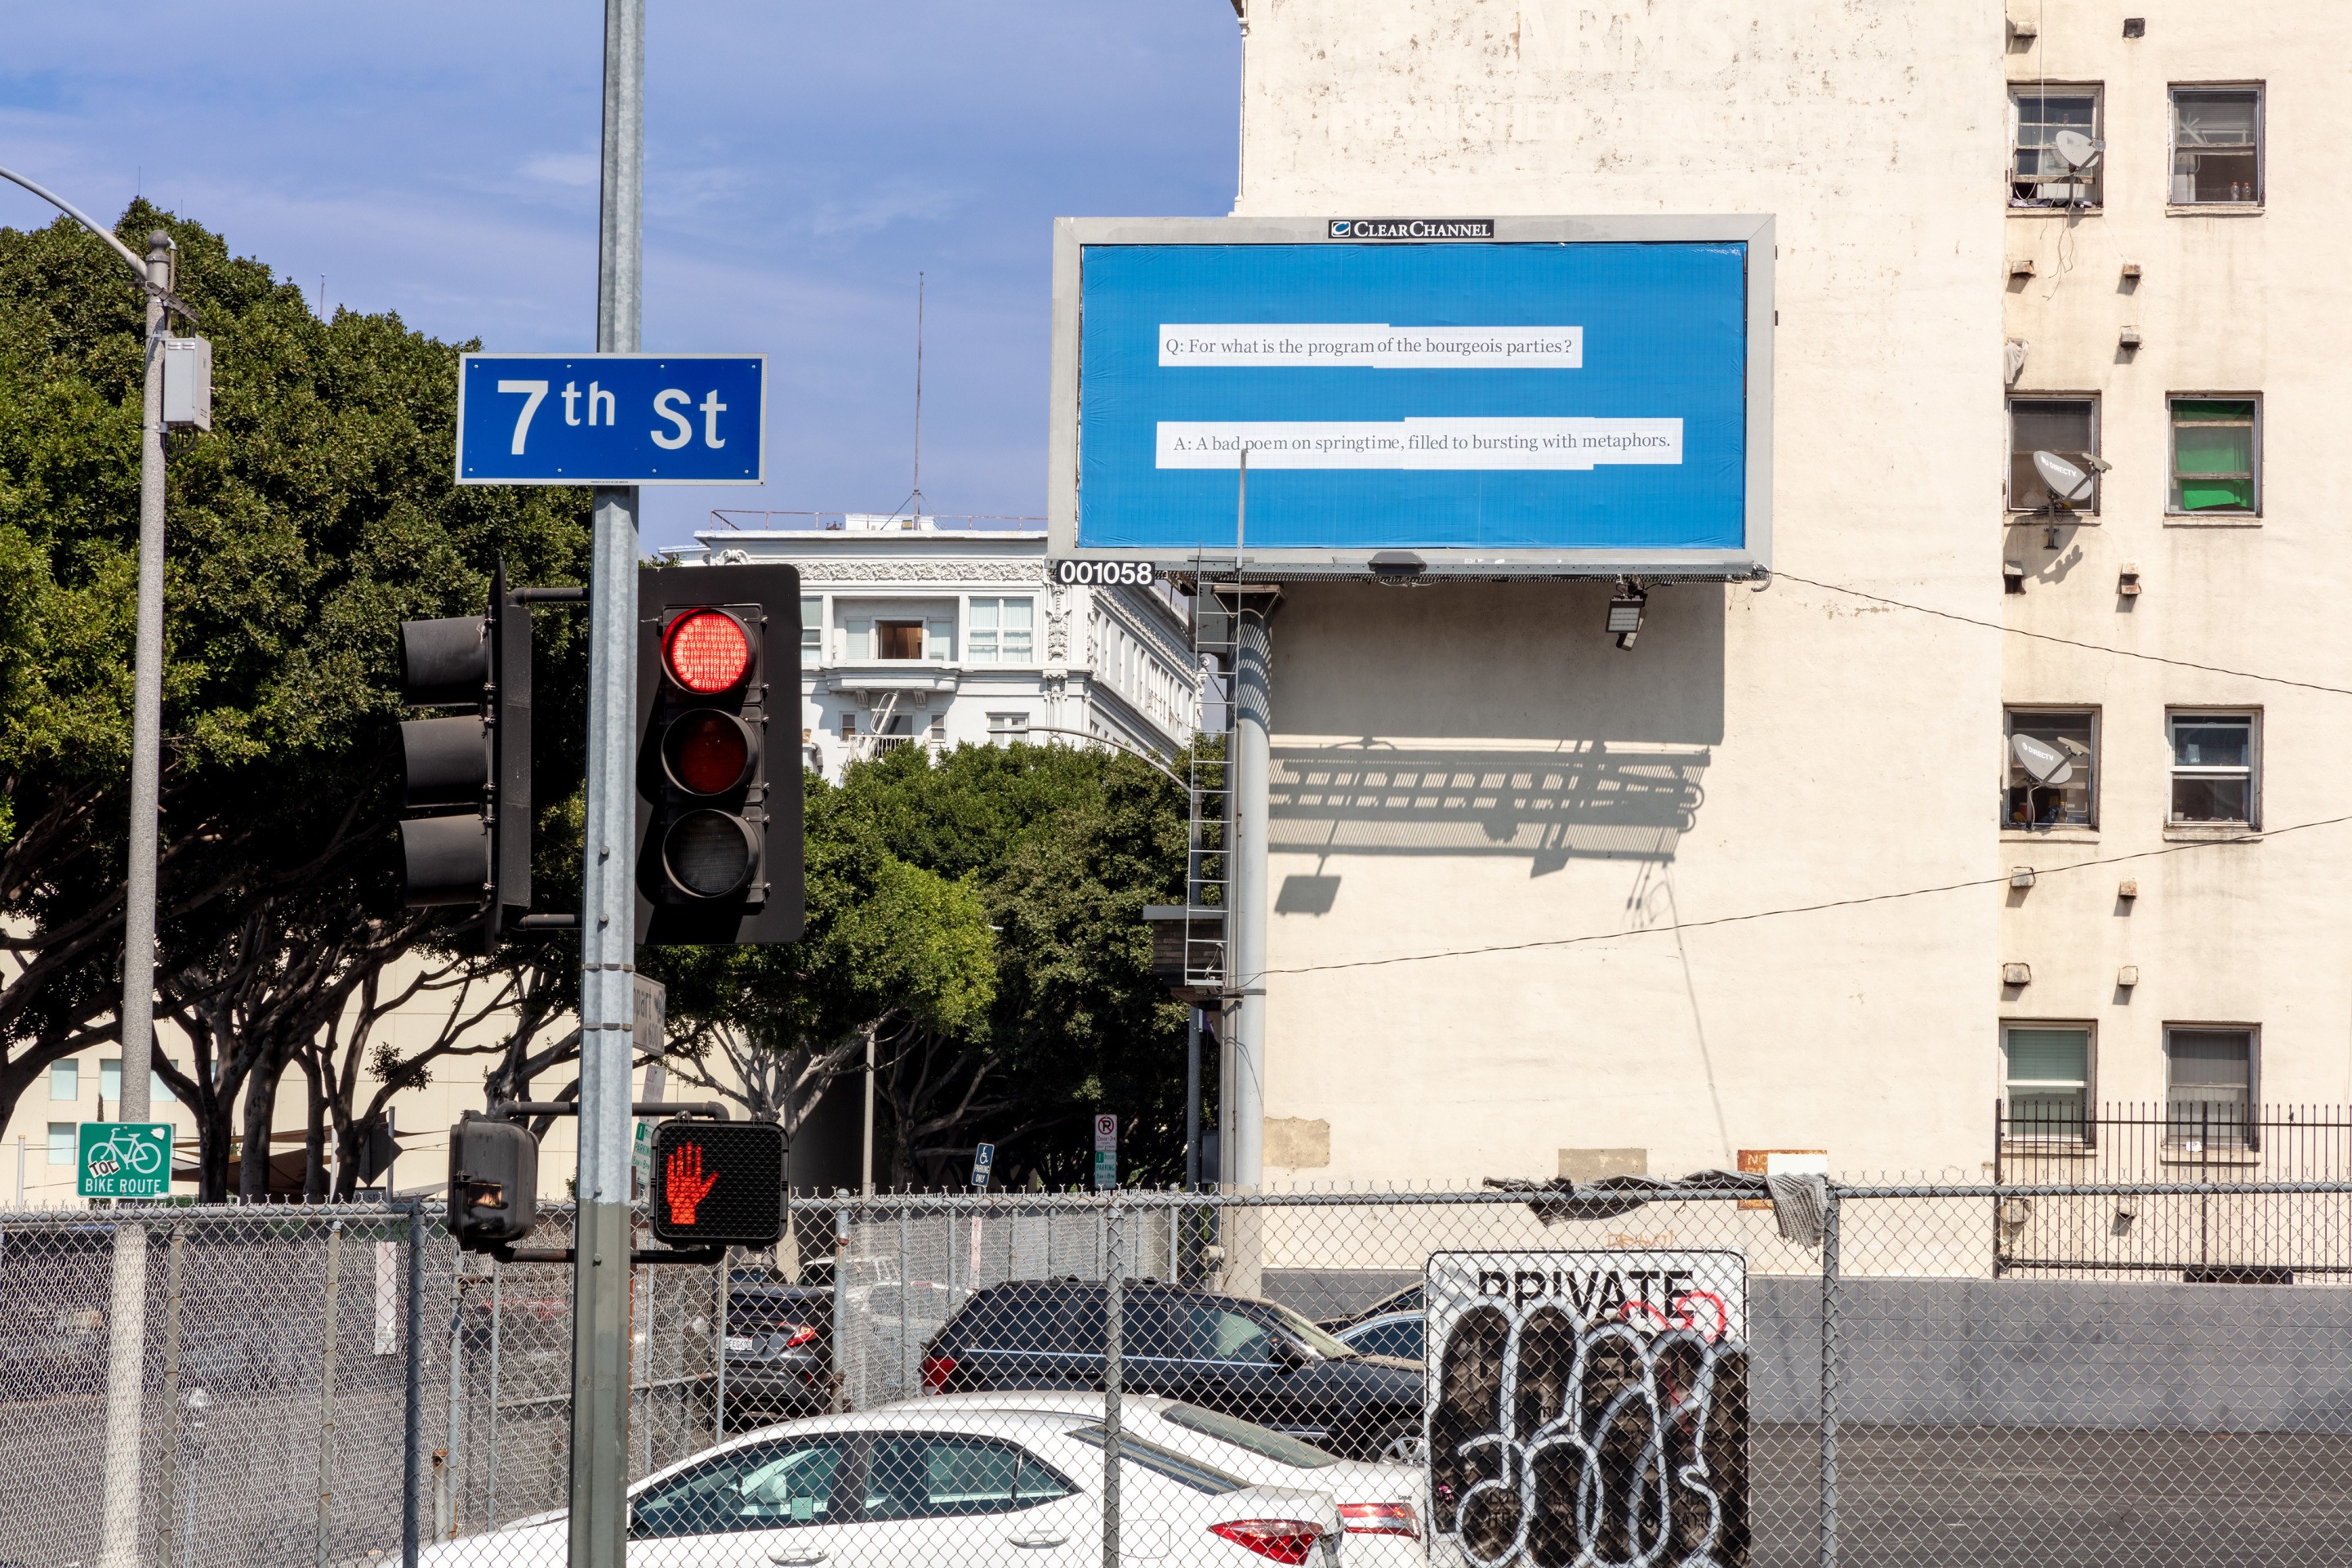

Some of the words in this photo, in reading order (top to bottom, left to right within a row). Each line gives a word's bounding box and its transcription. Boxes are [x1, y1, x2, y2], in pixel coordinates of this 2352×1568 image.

[1165, 338, 1184, 355] Q:
[1188, 338, 1217, 354] For
[1221, 337, 1258, 354] what
[1263, 338, 1275, 354] is
[1279, 337, 1303, 354] the
[1307, 341, 1374, 357] program
[1377, 336, 1395, 353] of
[1397, 337, 1422, 353] the
[1425, 336, 1503, 356] bourgeois
[497, 379, 616, 456] 7th
[650, 388, 727, 451] St
[1173, 436, 1192, 451] A:
[1196, 436, 1209, 451] A
[1212, 435, 1240, 451] bad
[1243, 439, 1288, 454] poem
[1292, 439, 1311, 450] on
[1315, 434, 1405, 453] springtime,
[1408, 434, 1448, 450] filled
[1452, 436, 1468, 449] to
[1472, 434, 1539, 452] bursting
[1543, 434, 1577, 449] with
[1582, 432, 1671, 451] metaphors.
[2049, 461, 2077, 477] DIRECTV
[1060, 560, 1153, 585] 001058
[2028, 746, 2054, 761] DIRECTV
[635, 1142, 652, 1158] PARKIN
[85, 1178, 114, 1192] BIKE
[119, 1178, 162, 1193] ROUTE
[1478, 1270, 1695, 1319] PRIVATE
